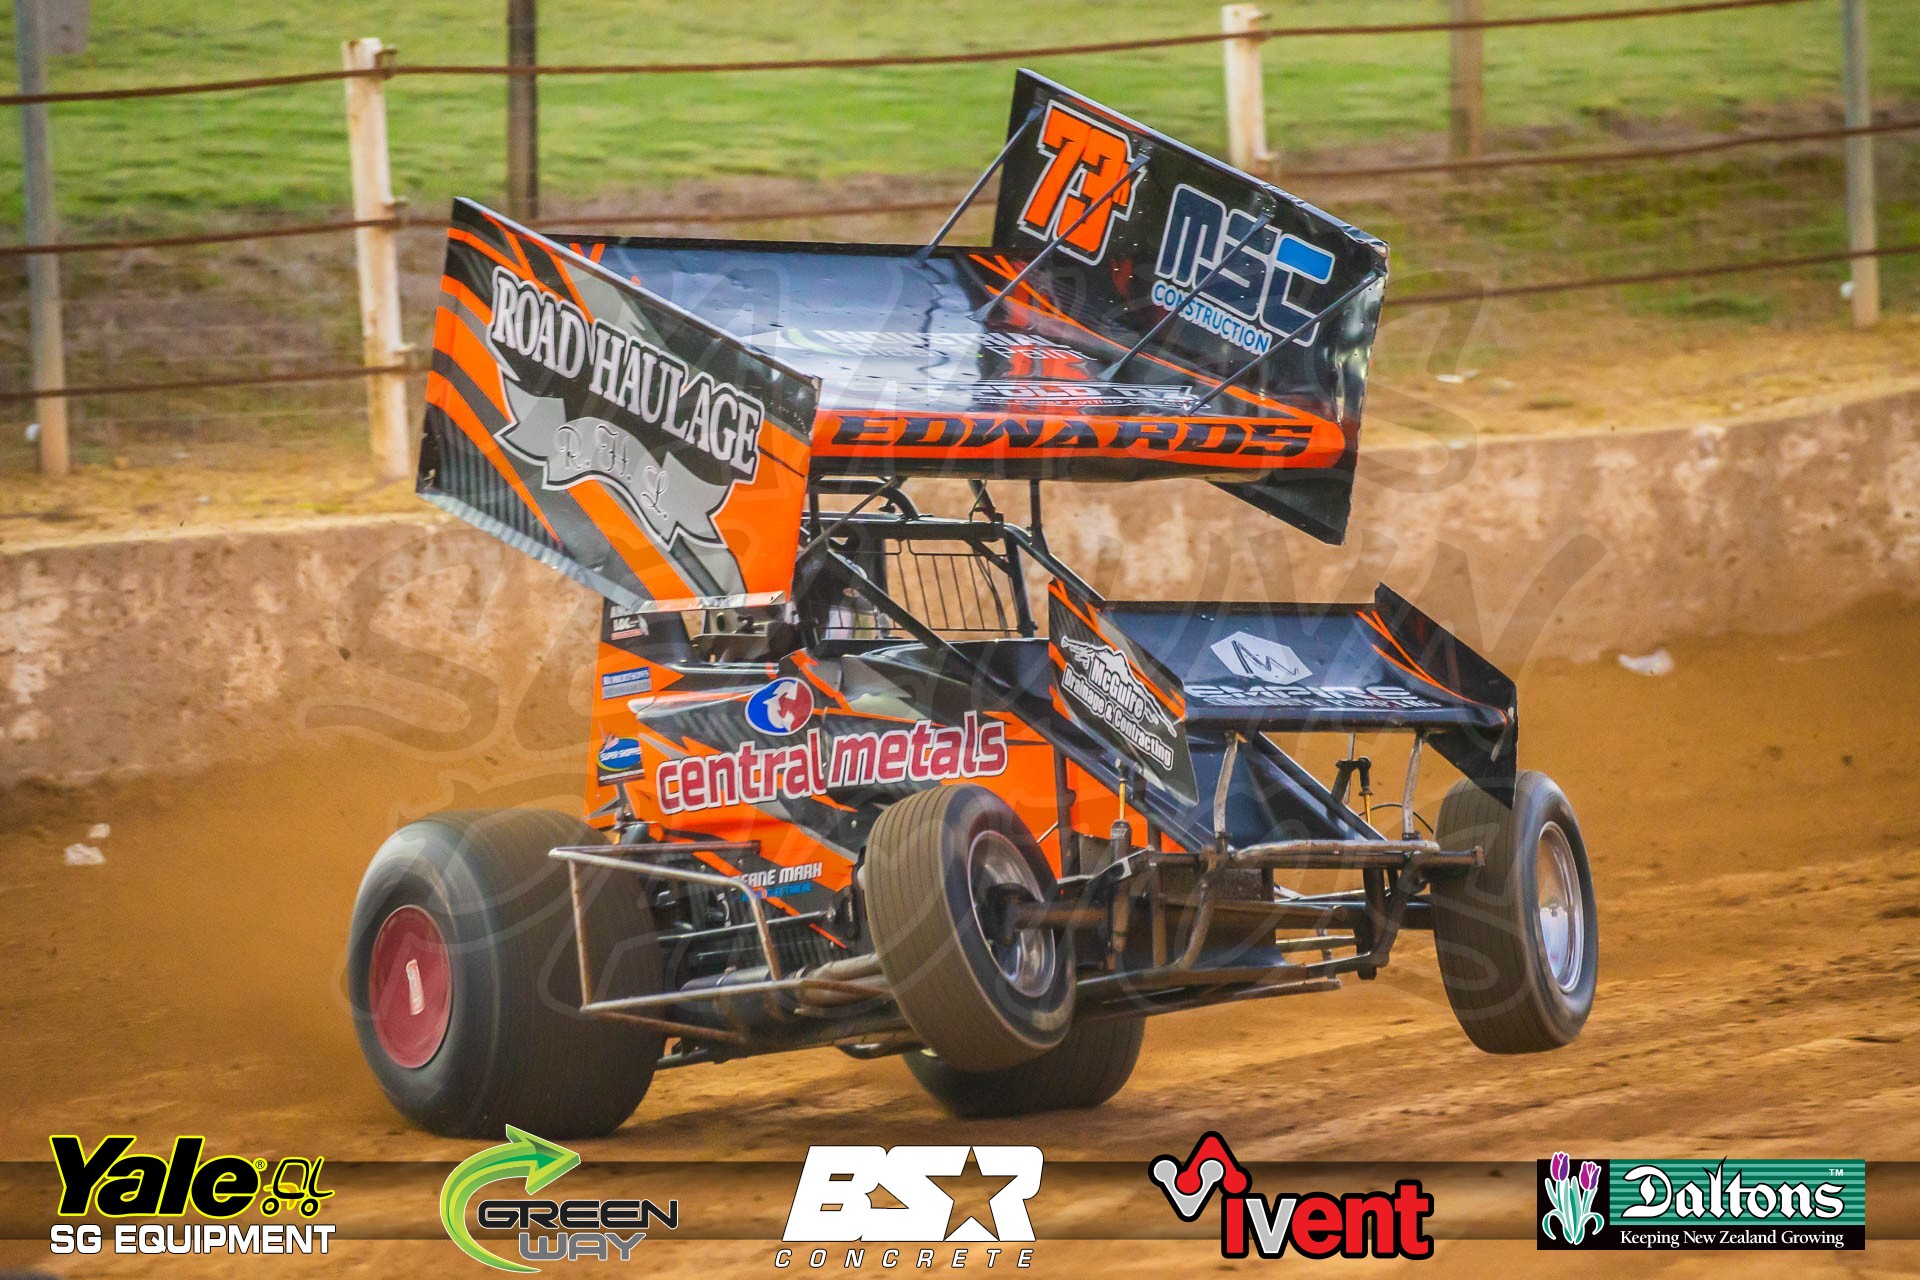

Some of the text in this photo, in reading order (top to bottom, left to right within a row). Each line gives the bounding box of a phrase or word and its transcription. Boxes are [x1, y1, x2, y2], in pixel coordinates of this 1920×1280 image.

[1155, 183, 1335, 347] MSC
[812, 329, 1072, 349] INDUSTRIAL
[1152, 281, 1272, 356] CONSTRUCTION
[490, 274, 762, 476] ROAD HAULAGE
[985, 345, 1098, 361] Paint
[832, 415, 1313, 456] EDWARDS
[1063, 667, 1172, 768] Drainage & Contracting
[1091, 657, 1146, 719] McGuire
[1184, 685, 1419, 700] EMPIRE
[657, 710, 1008, 815] central metals
[778, 861, 823, 884] MARK
